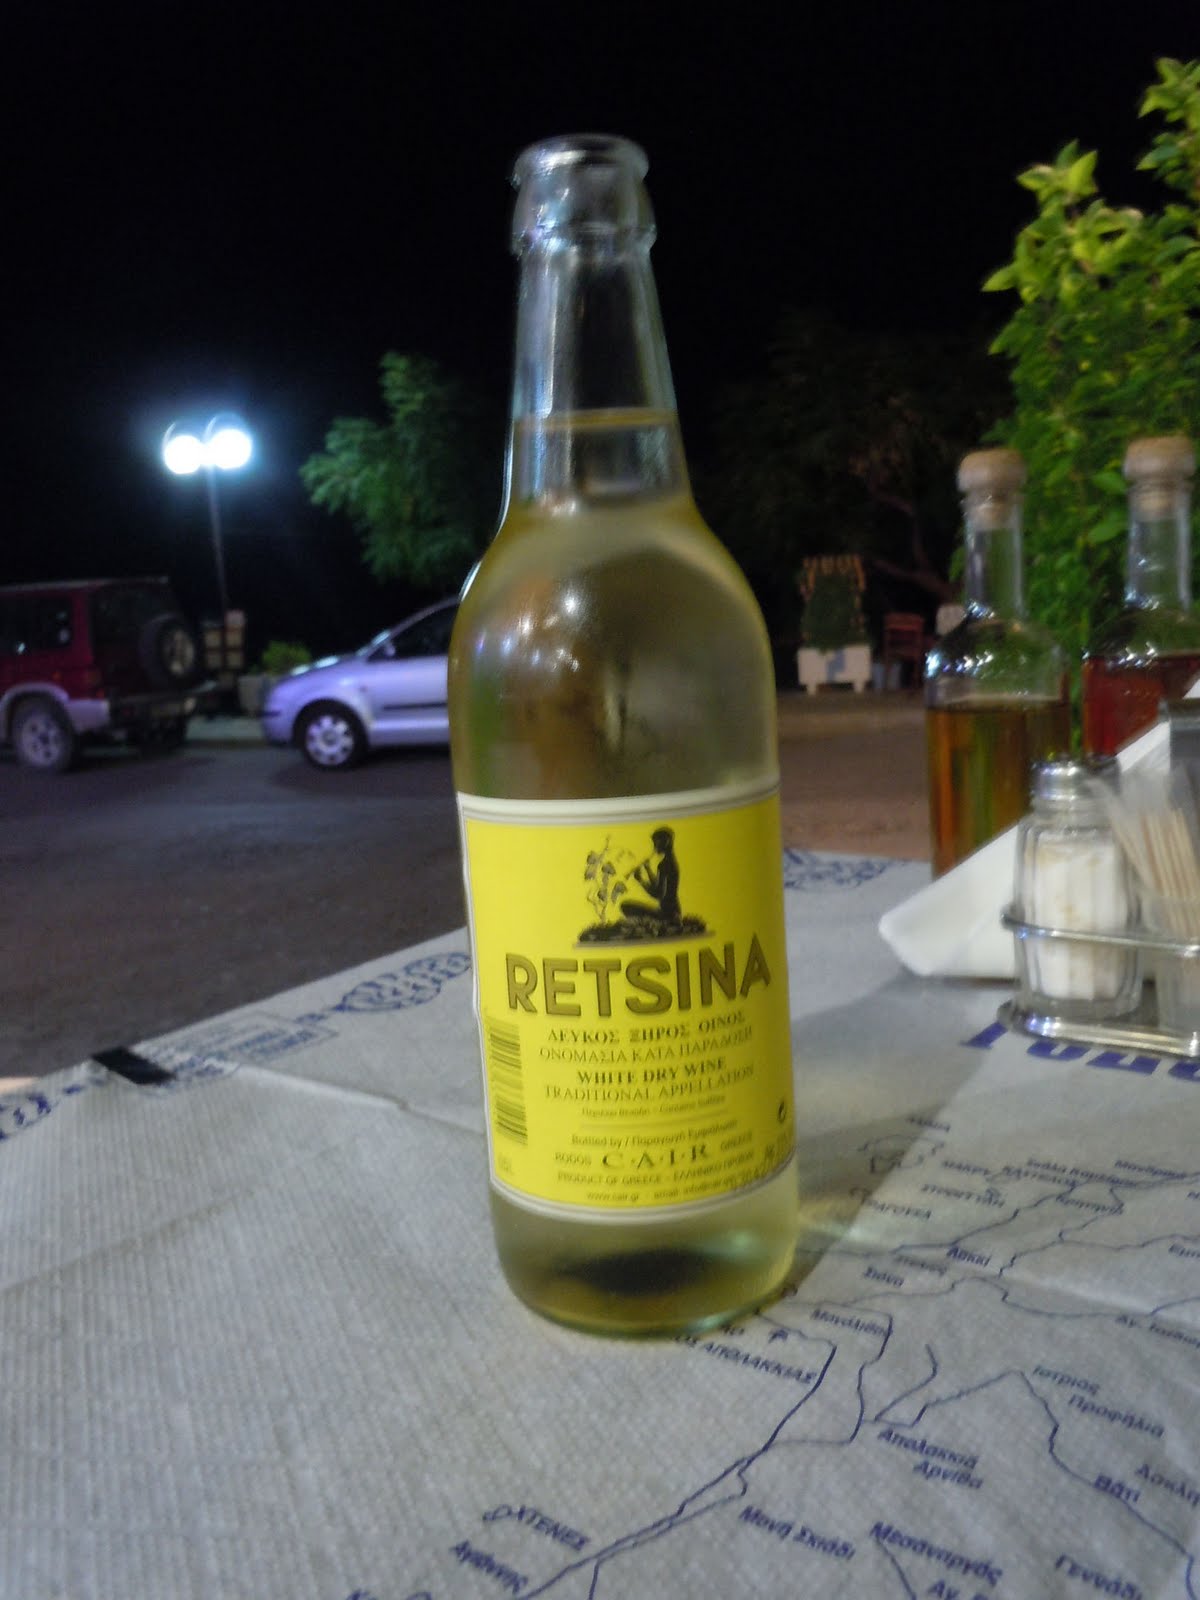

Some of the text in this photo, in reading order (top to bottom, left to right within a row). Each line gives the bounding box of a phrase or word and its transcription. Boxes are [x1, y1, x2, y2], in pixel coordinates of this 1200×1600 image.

[506, 932, 771, 1016] RETSINA
[548, 1029, 619, 1045] ΛΕΥΚΟΣ
[698, 1011, 745, 1032] ΟΙΝΟΣ
[540, 1047, 627, 1063] ΟΝΟΜΑΣΙΑ
[578, 1056, 726, 1084] WHITE DRY WINE
[545, 1063, 754, 1101] TRADITIONAL APPELLATION
[610, 1134, 622, 1149] by
